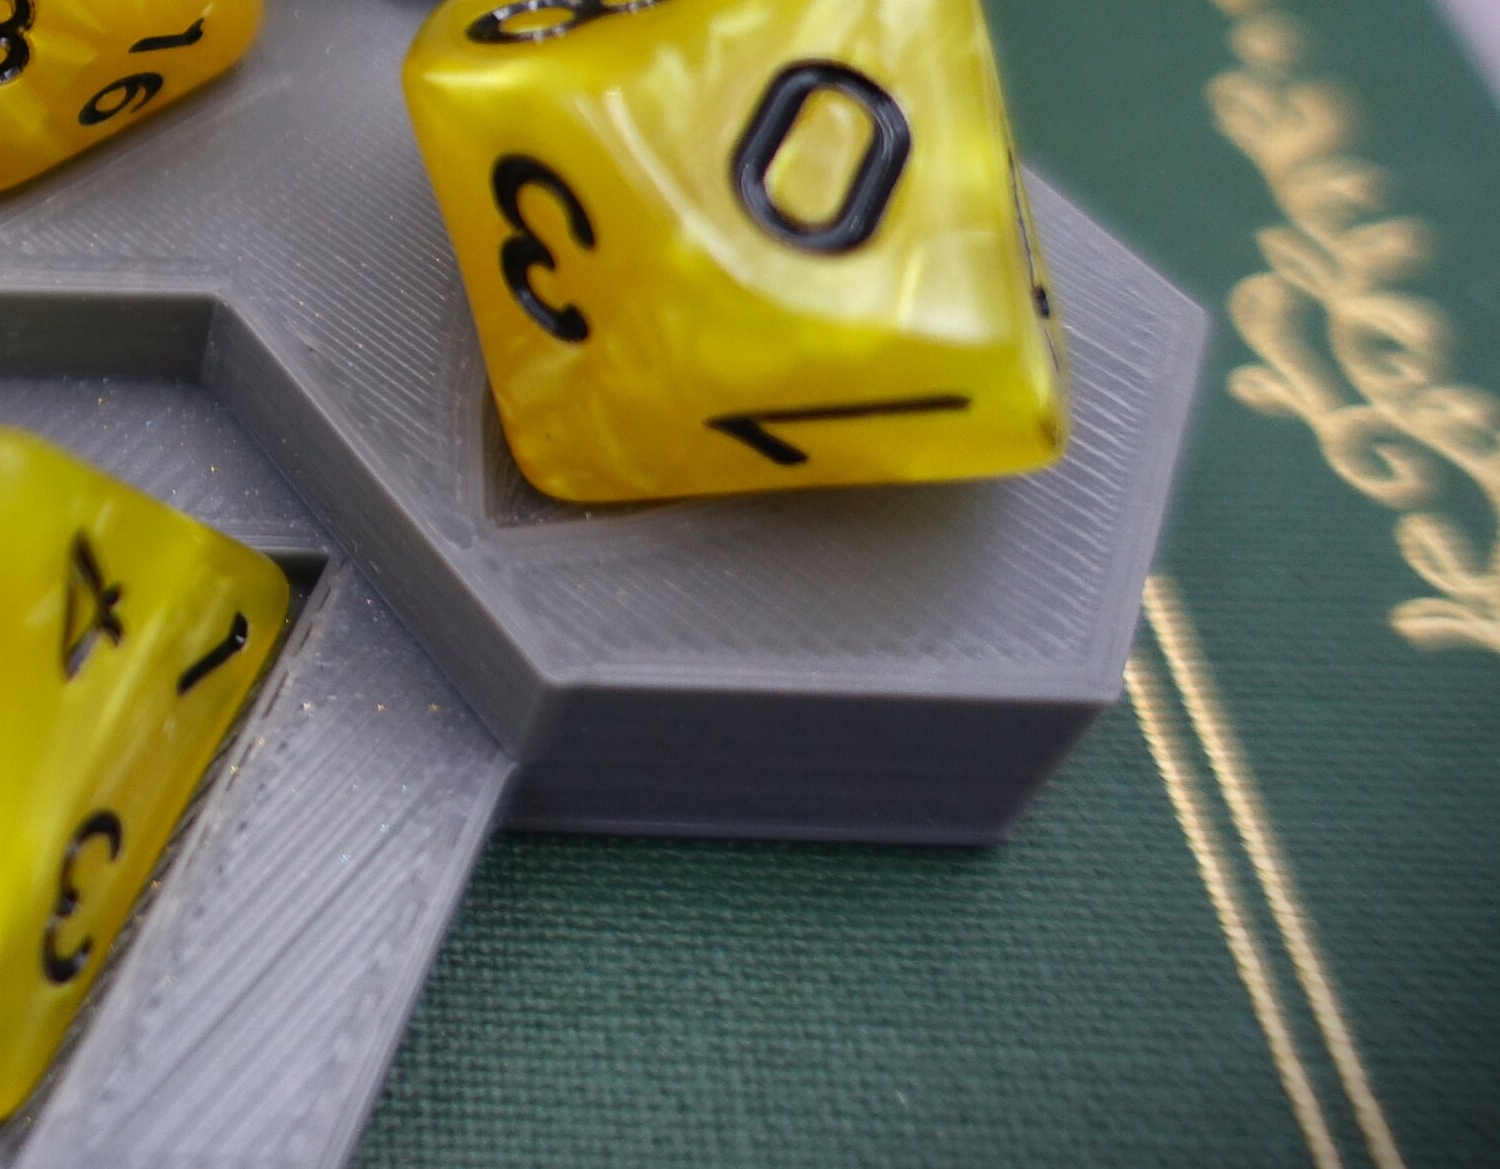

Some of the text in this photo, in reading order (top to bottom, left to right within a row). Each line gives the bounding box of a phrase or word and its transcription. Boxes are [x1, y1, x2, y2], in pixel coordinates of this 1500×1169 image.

[729, 60, 911, 256] 0
[492, 154, 595, 342] 3
[61, 531, 124, 680] 4
[177, 610, 250, 696] 1
[41, 809, 123, 985] 3
